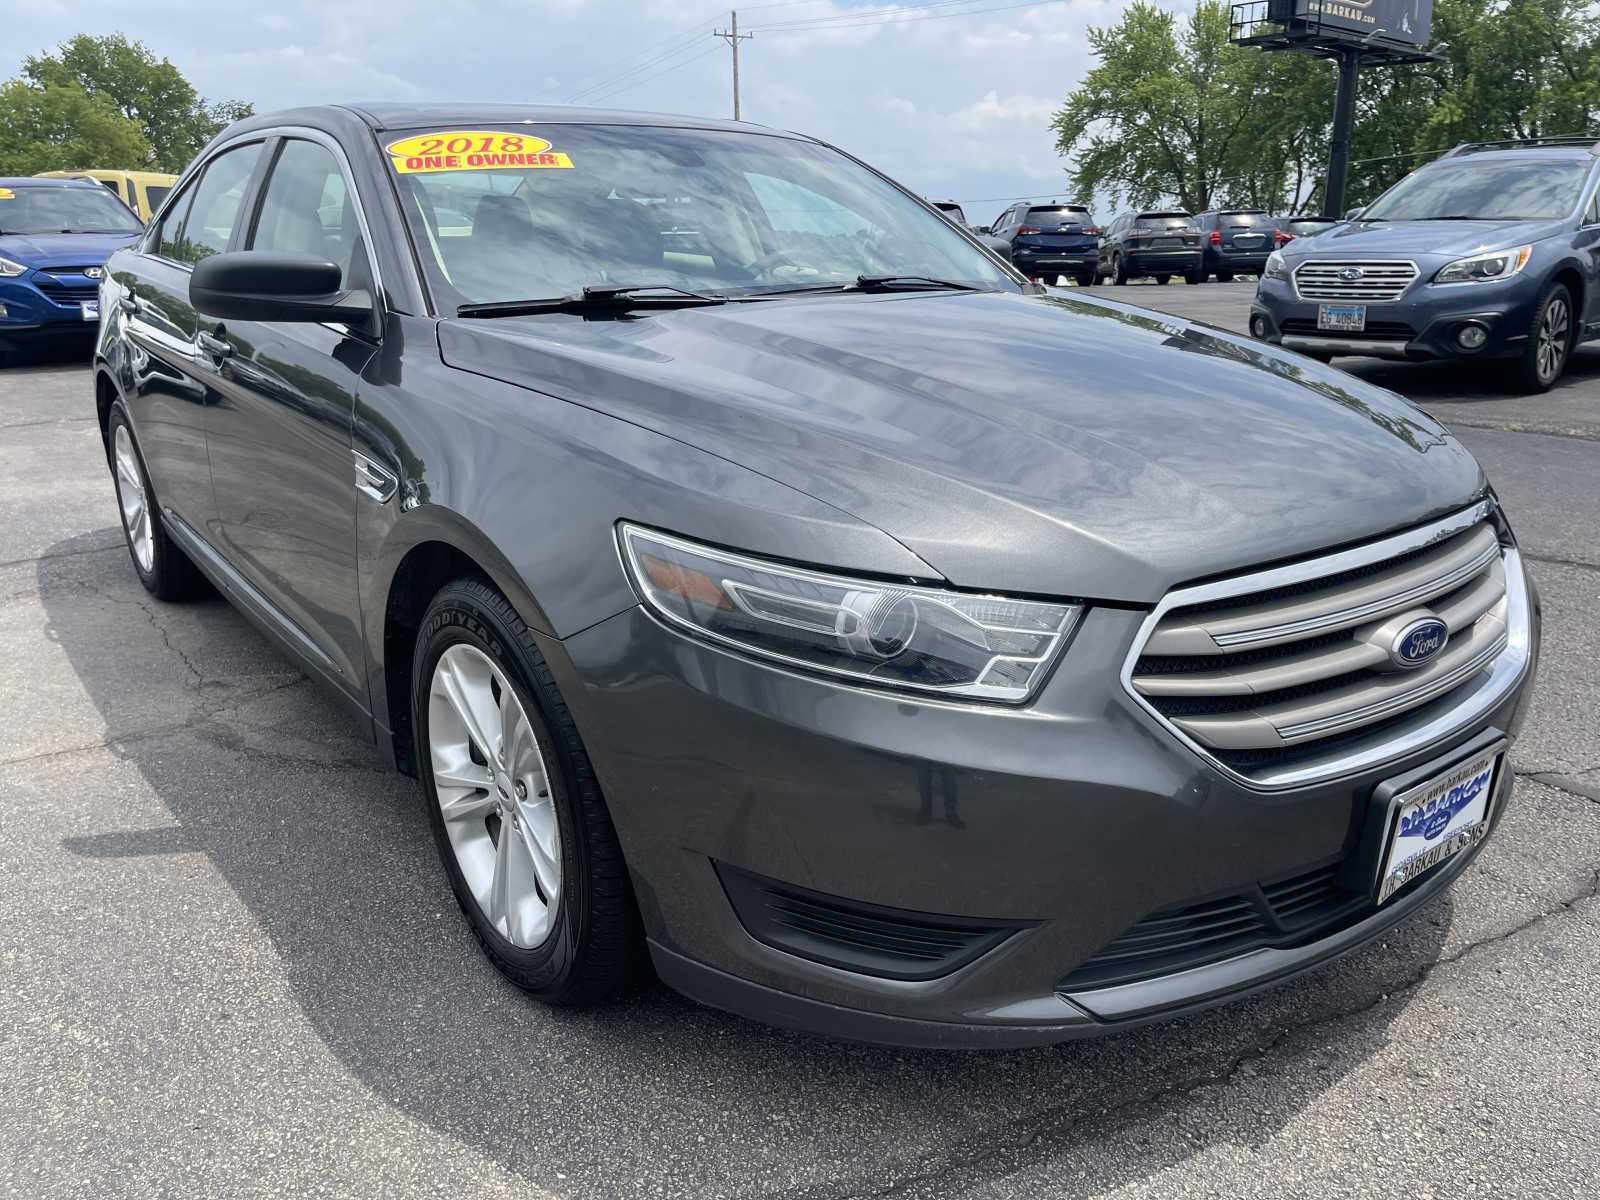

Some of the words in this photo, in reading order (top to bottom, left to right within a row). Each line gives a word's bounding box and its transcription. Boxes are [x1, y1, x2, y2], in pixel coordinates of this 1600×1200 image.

[419, 137, 523, 155] 2018
[405, 155, 462, 170] ONE
[466, 153, 557, 167] OWNER
[1410, 628, 1439, 657] Ford
[1401, 844, 1441, 884] BARKAU
[1444, 843, 1453, 857] &
[1456, 822, 1485, 850] SONS
